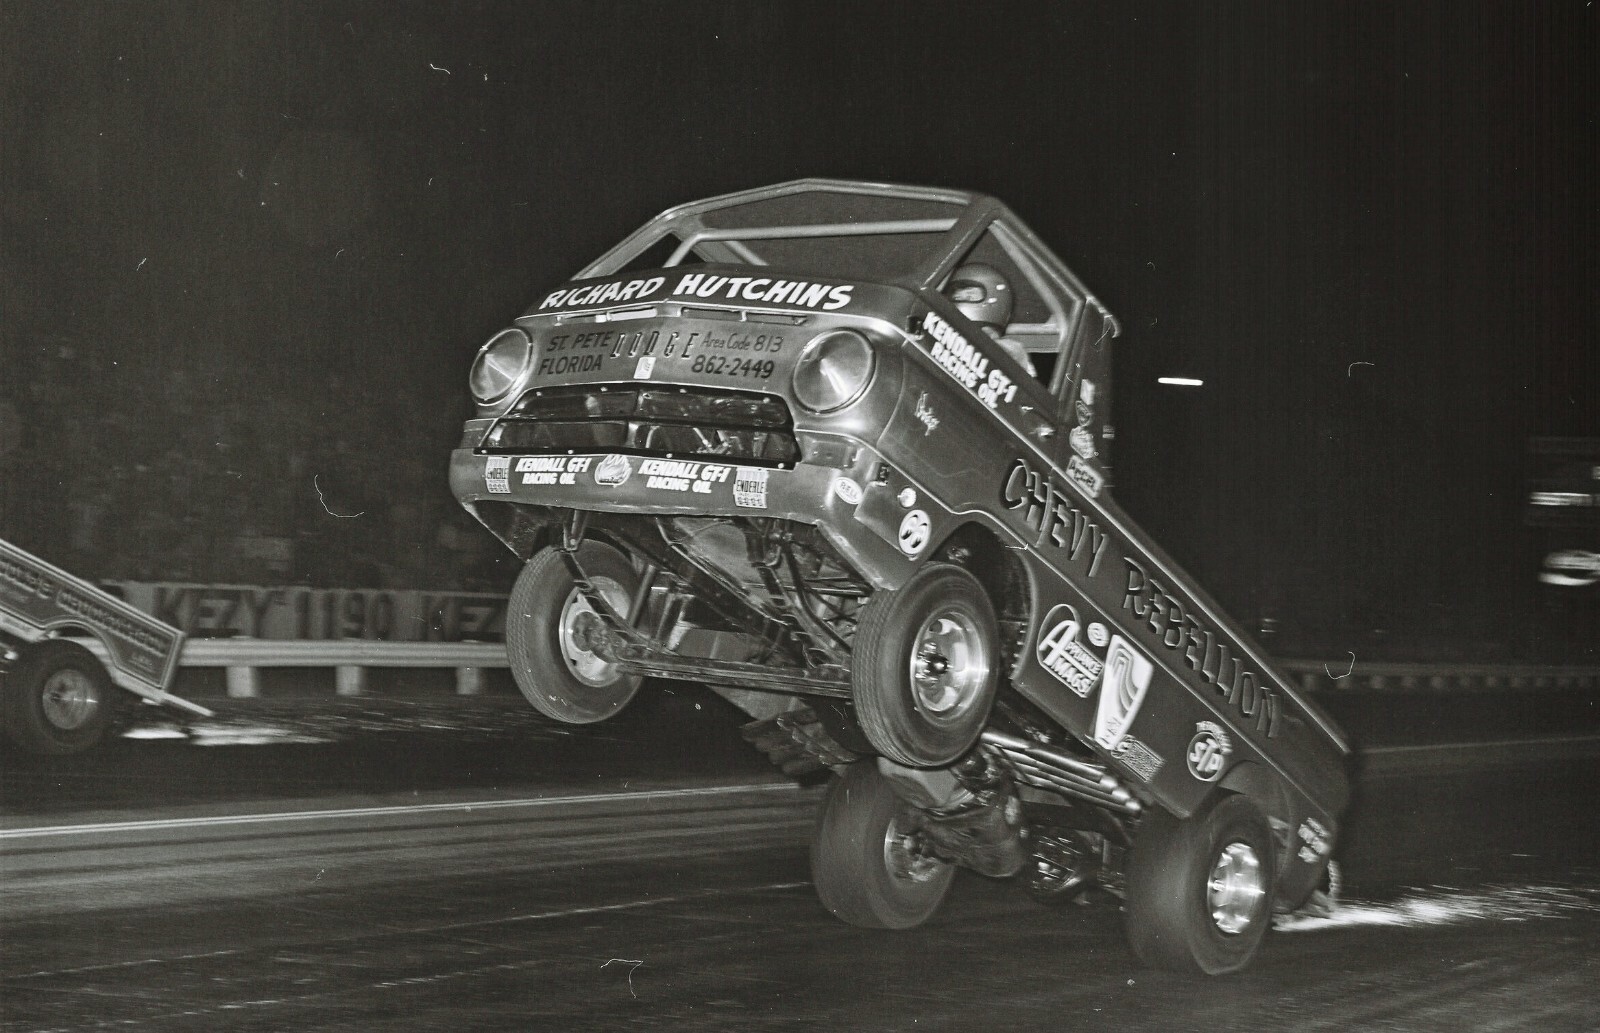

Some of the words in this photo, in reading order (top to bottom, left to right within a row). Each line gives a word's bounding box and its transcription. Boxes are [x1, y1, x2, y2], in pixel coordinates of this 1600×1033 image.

[539, 276, 666, 310] RICHARD
[672, 273, 854, 311] HUTCHINS
[571, 330, 615, 349] PETE
[609, 331, 699, 359] DODGE
[702, 331, 725, 350] Area
[726, 332, 751, 352] Code
[753, 335, 784, 353] 813
[922, 311, 989, 380] KENDALL
[538, 354, 604, 376] FLORIDA
[690, 356, 775, 380] 862-2449
[930, 341, 979, 388] RACING
[977, 382, 999, 410] OIL
[515, 457, 568, 473] KENDALL
[638, 459, 703, 480] KENDALL
[522, 472, 558, 485] RACING
[559, 472, 576, 485] OIL
[646, 474, 691, 491] RACING
[691, 479, 712, 494] OIL
[736, 479, 765, 494] ENDERLE
[1003, 458, 1108, 577] CHEVY
[1123, 556, 1280, 738] REBELLION
[153, 586, 272, 640] KEZY
[293, 590, 398, 640] 1190
[420, 594, 508, 642] KEZ
[1189, 738, 1224, 772] STP
